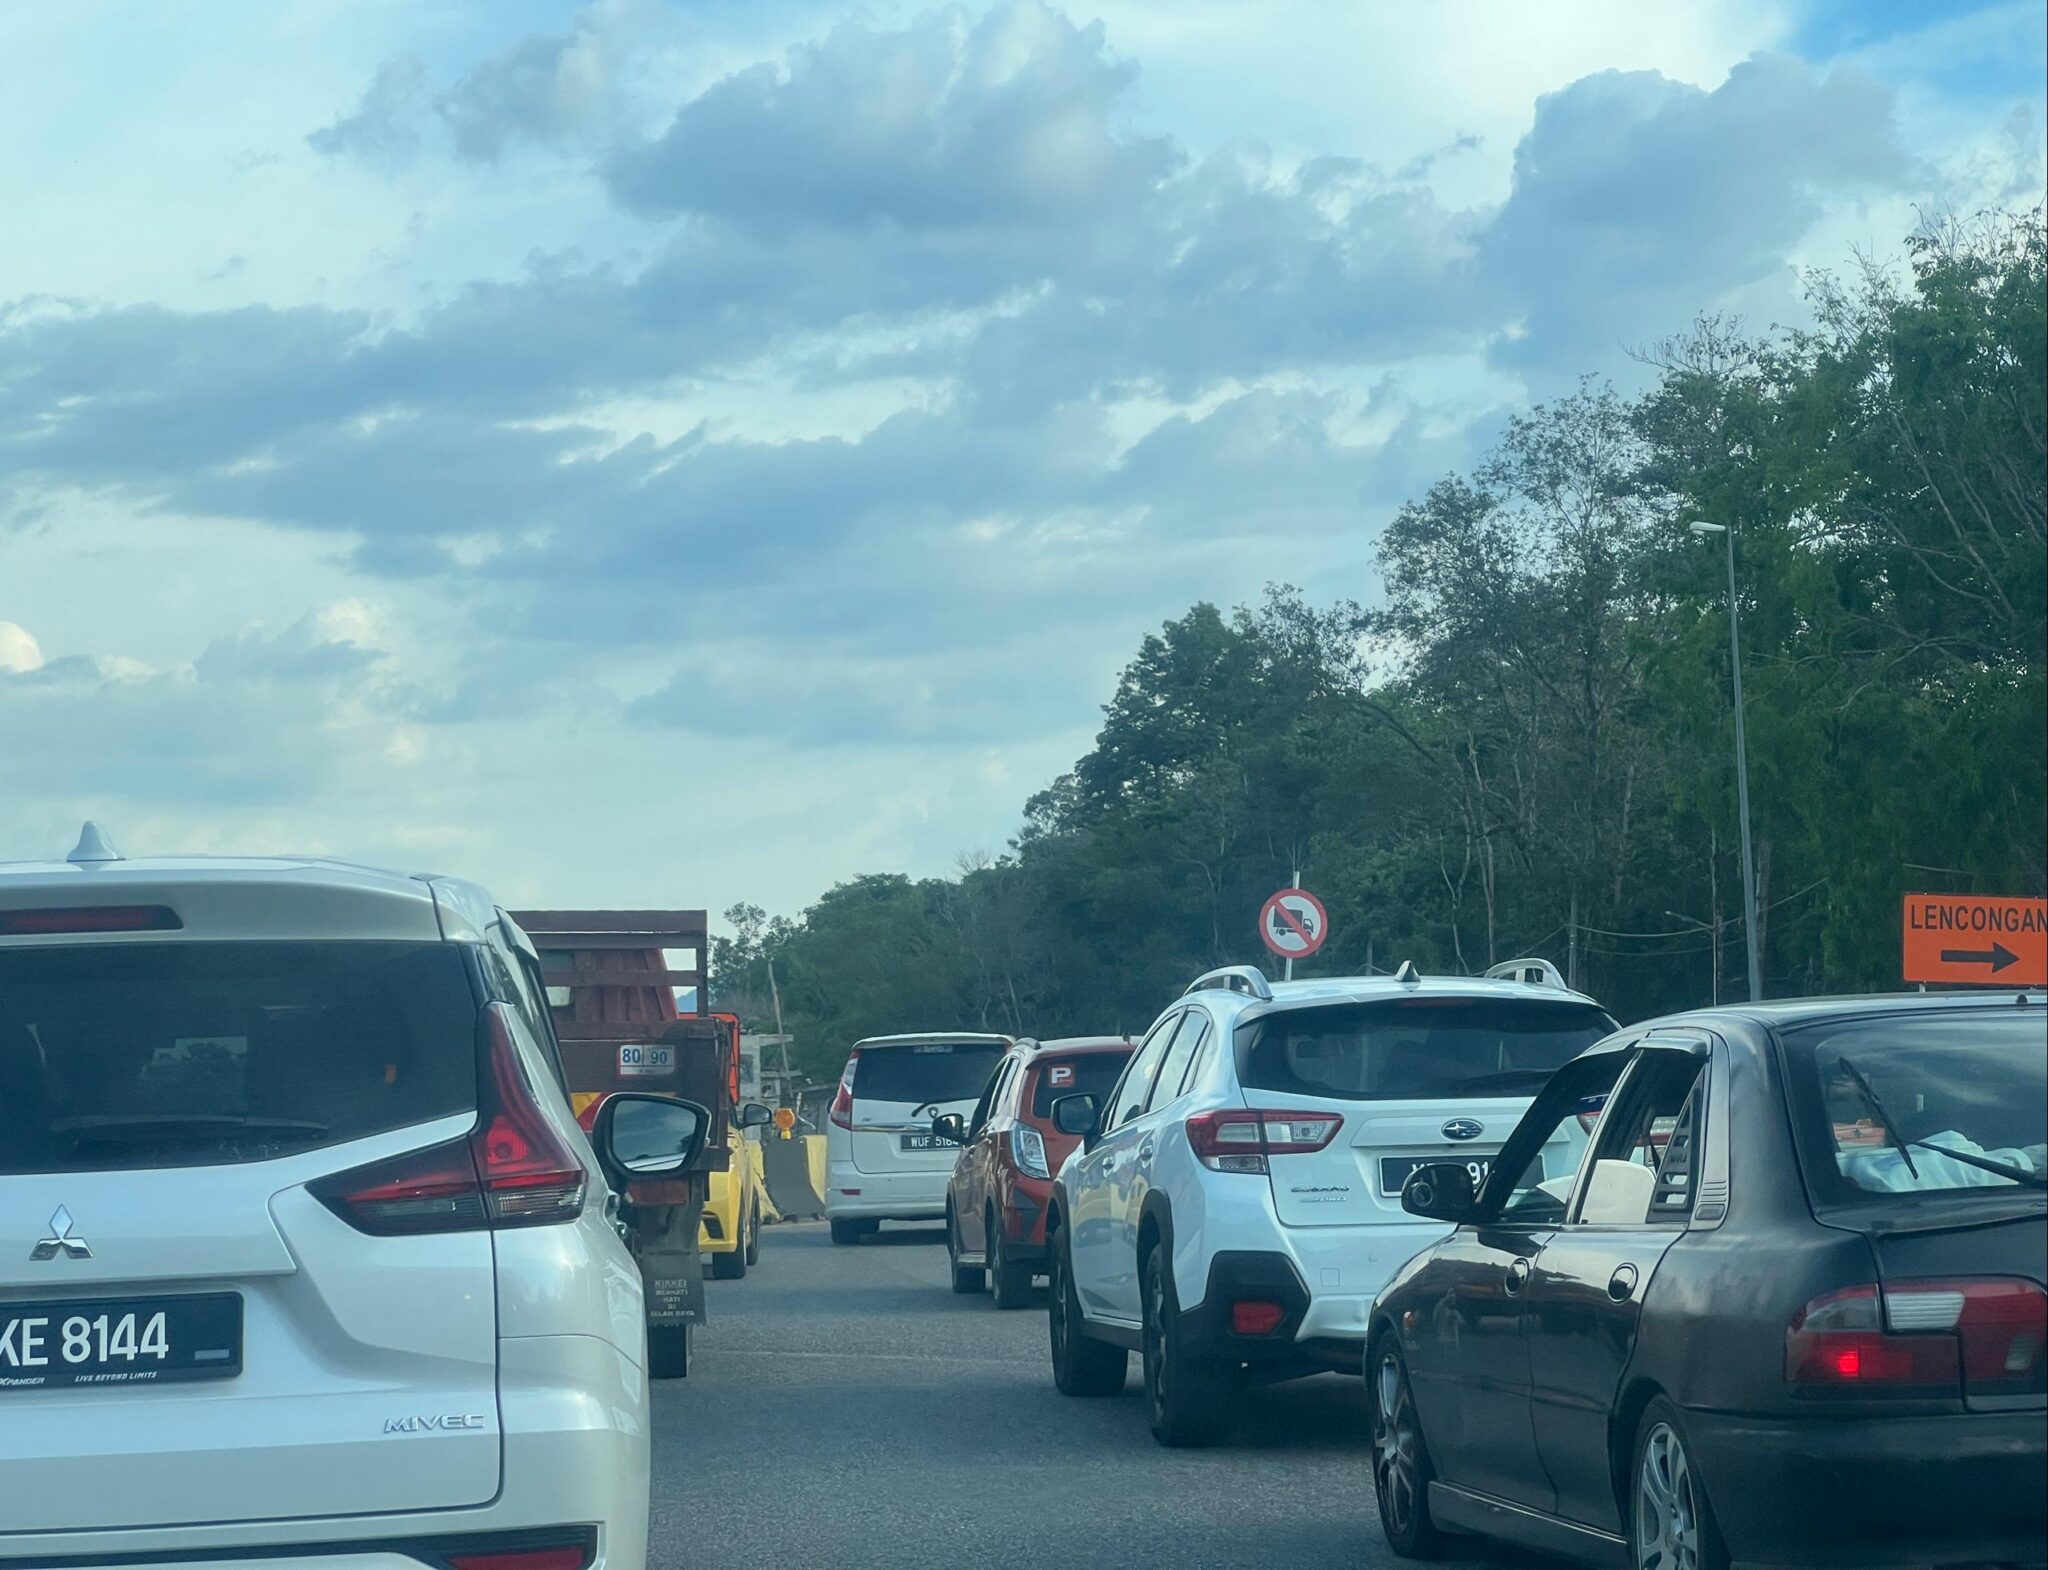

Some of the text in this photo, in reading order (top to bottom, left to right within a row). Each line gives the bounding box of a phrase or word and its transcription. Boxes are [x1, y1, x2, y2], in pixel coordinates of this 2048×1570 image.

[1911, 904, 2047, 932] LENCONGAN
[623, 1048, 641, 1063] 80
[651, 1051, 667, 1064] 90
[1051, 1067, 1072, 1084] P
[911, 1137, 930, 1147] WUF
[61, 1312, 169, 1363] 8144
[129, 1371, 157, 1380] LIMITS
[384, 1415, 485, 1434] MIVEC
